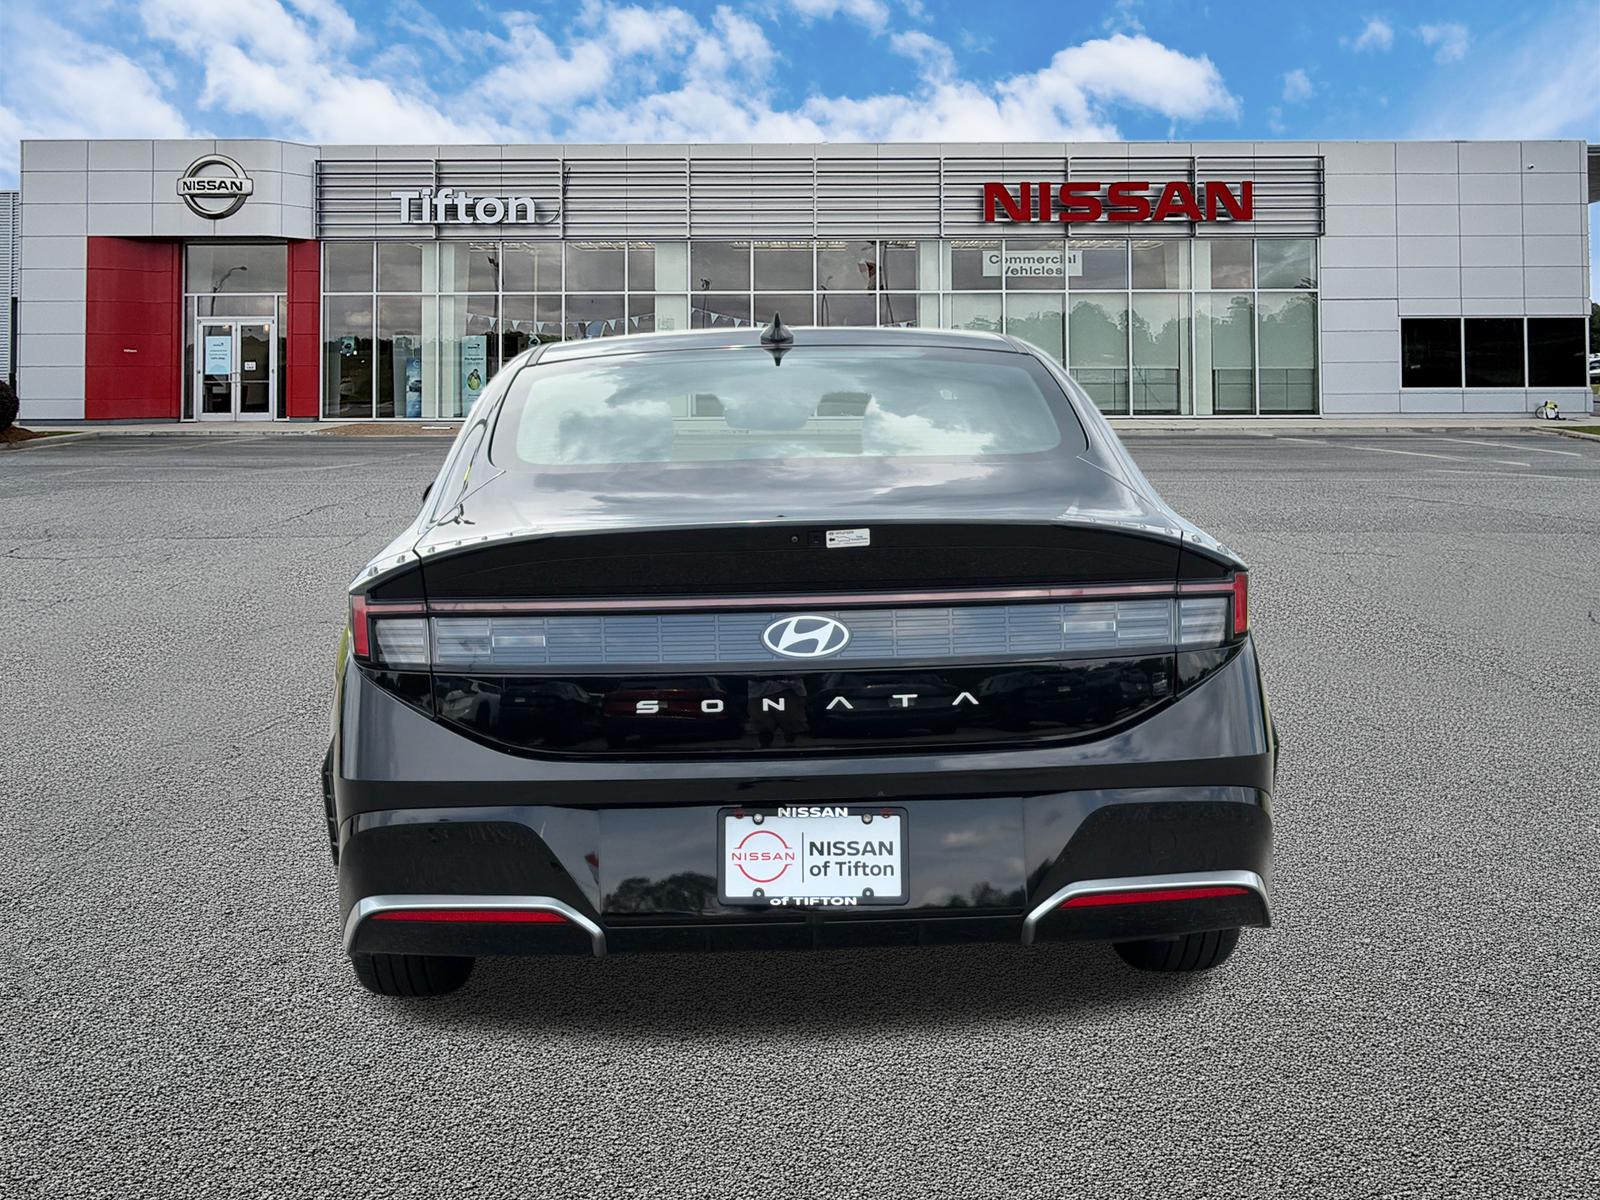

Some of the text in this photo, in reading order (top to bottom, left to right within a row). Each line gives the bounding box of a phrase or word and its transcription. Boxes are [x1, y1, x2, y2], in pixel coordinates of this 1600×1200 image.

[182, 180, 243, 192] NISSAN
[391, 188, 537, 225] Tifton
[983, 180, 1253, 222] NISSAN
[635, 691, 980, 714] SONATA
[777, 807, 849, 818] NISSAN
[731, 852, 795, 861] NISSAN
[808, 841, 894, 857] NISSAN
[809, 860, 895, 877] of Tifton
[769, 896, 857, 906] of TIFTON
